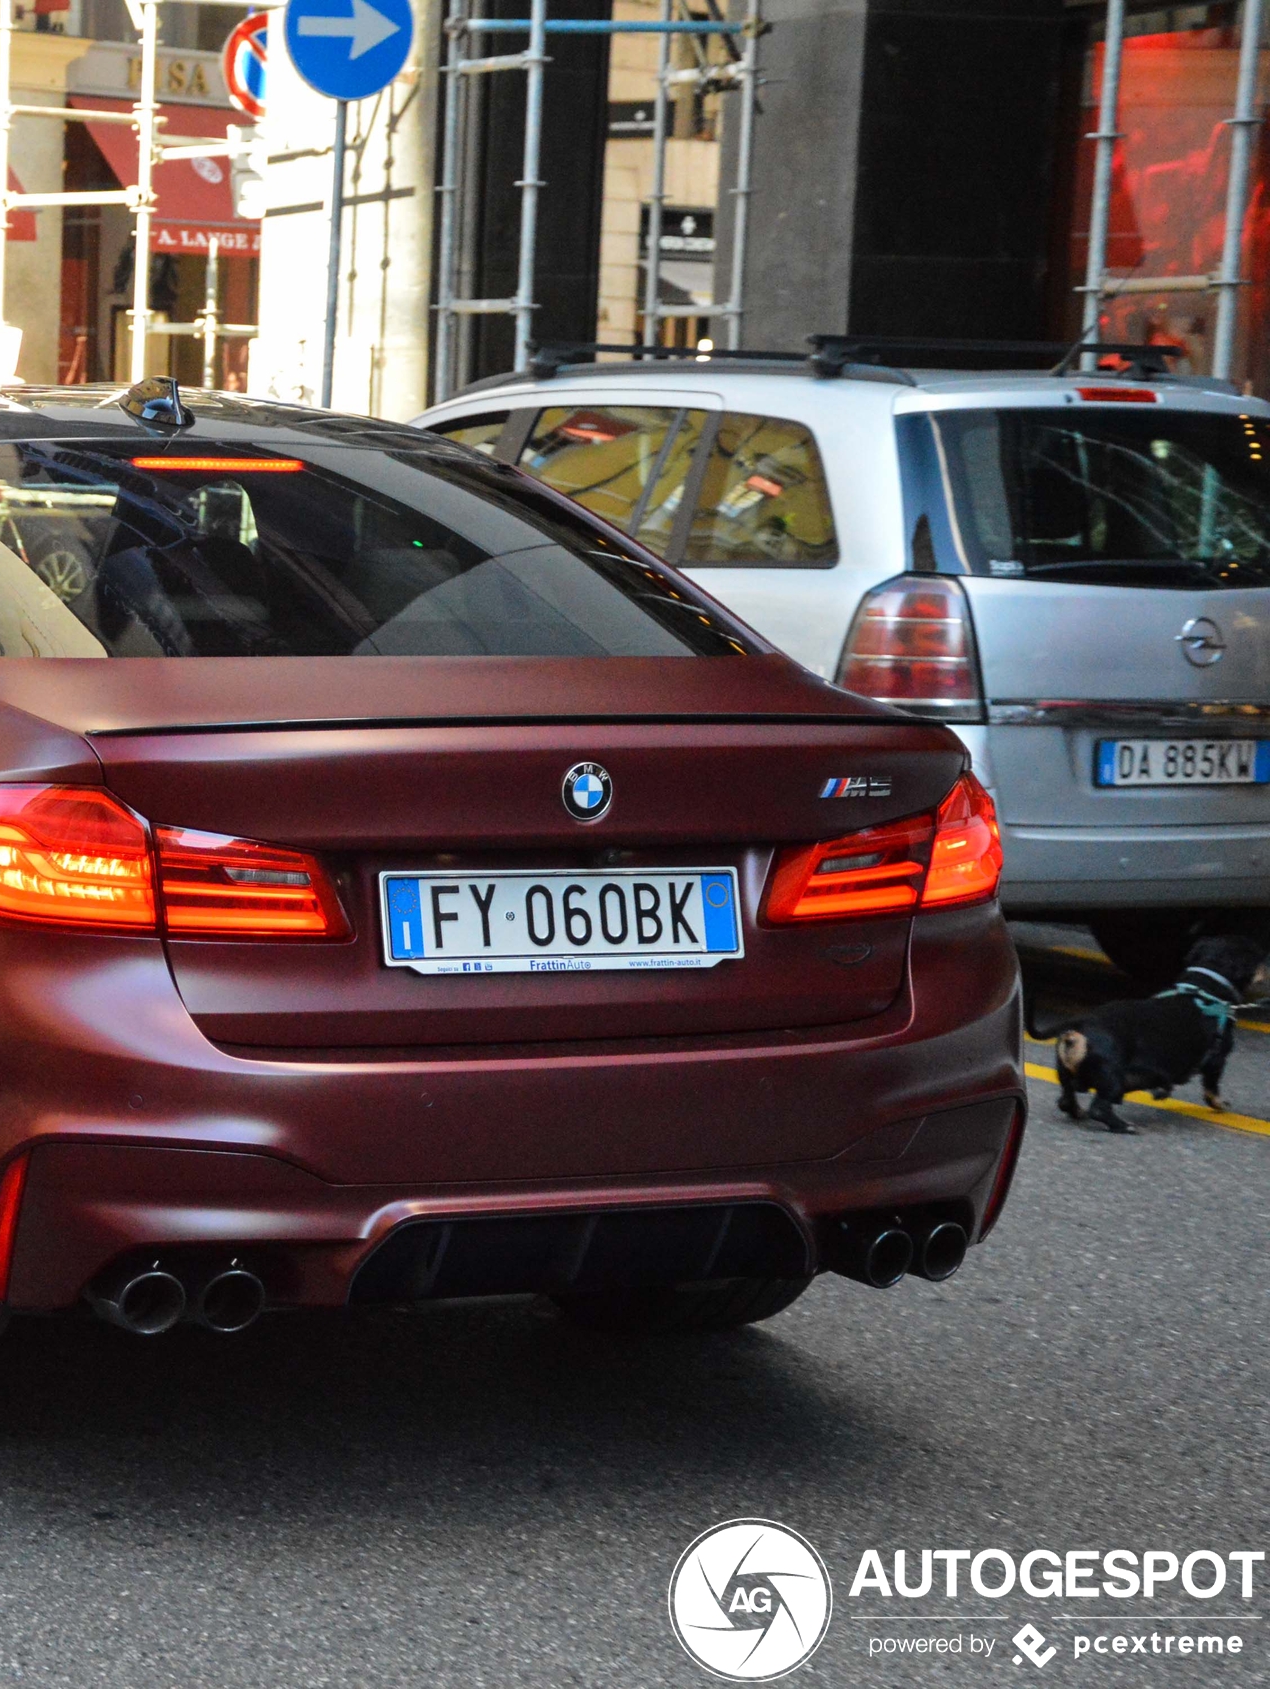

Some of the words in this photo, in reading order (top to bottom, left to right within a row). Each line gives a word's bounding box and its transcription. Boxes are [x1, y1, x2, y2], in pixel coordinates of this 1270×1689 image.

[1119, 744, 1151, 780] DA
[568, 764, 609, 783] BMW
[840, 776, 893, 798] M5
[430, 883, 497, 949] FY
[525, 882, 700, 947] 060BK
[629, 958, 701, 968] www.frattin-auto.it
